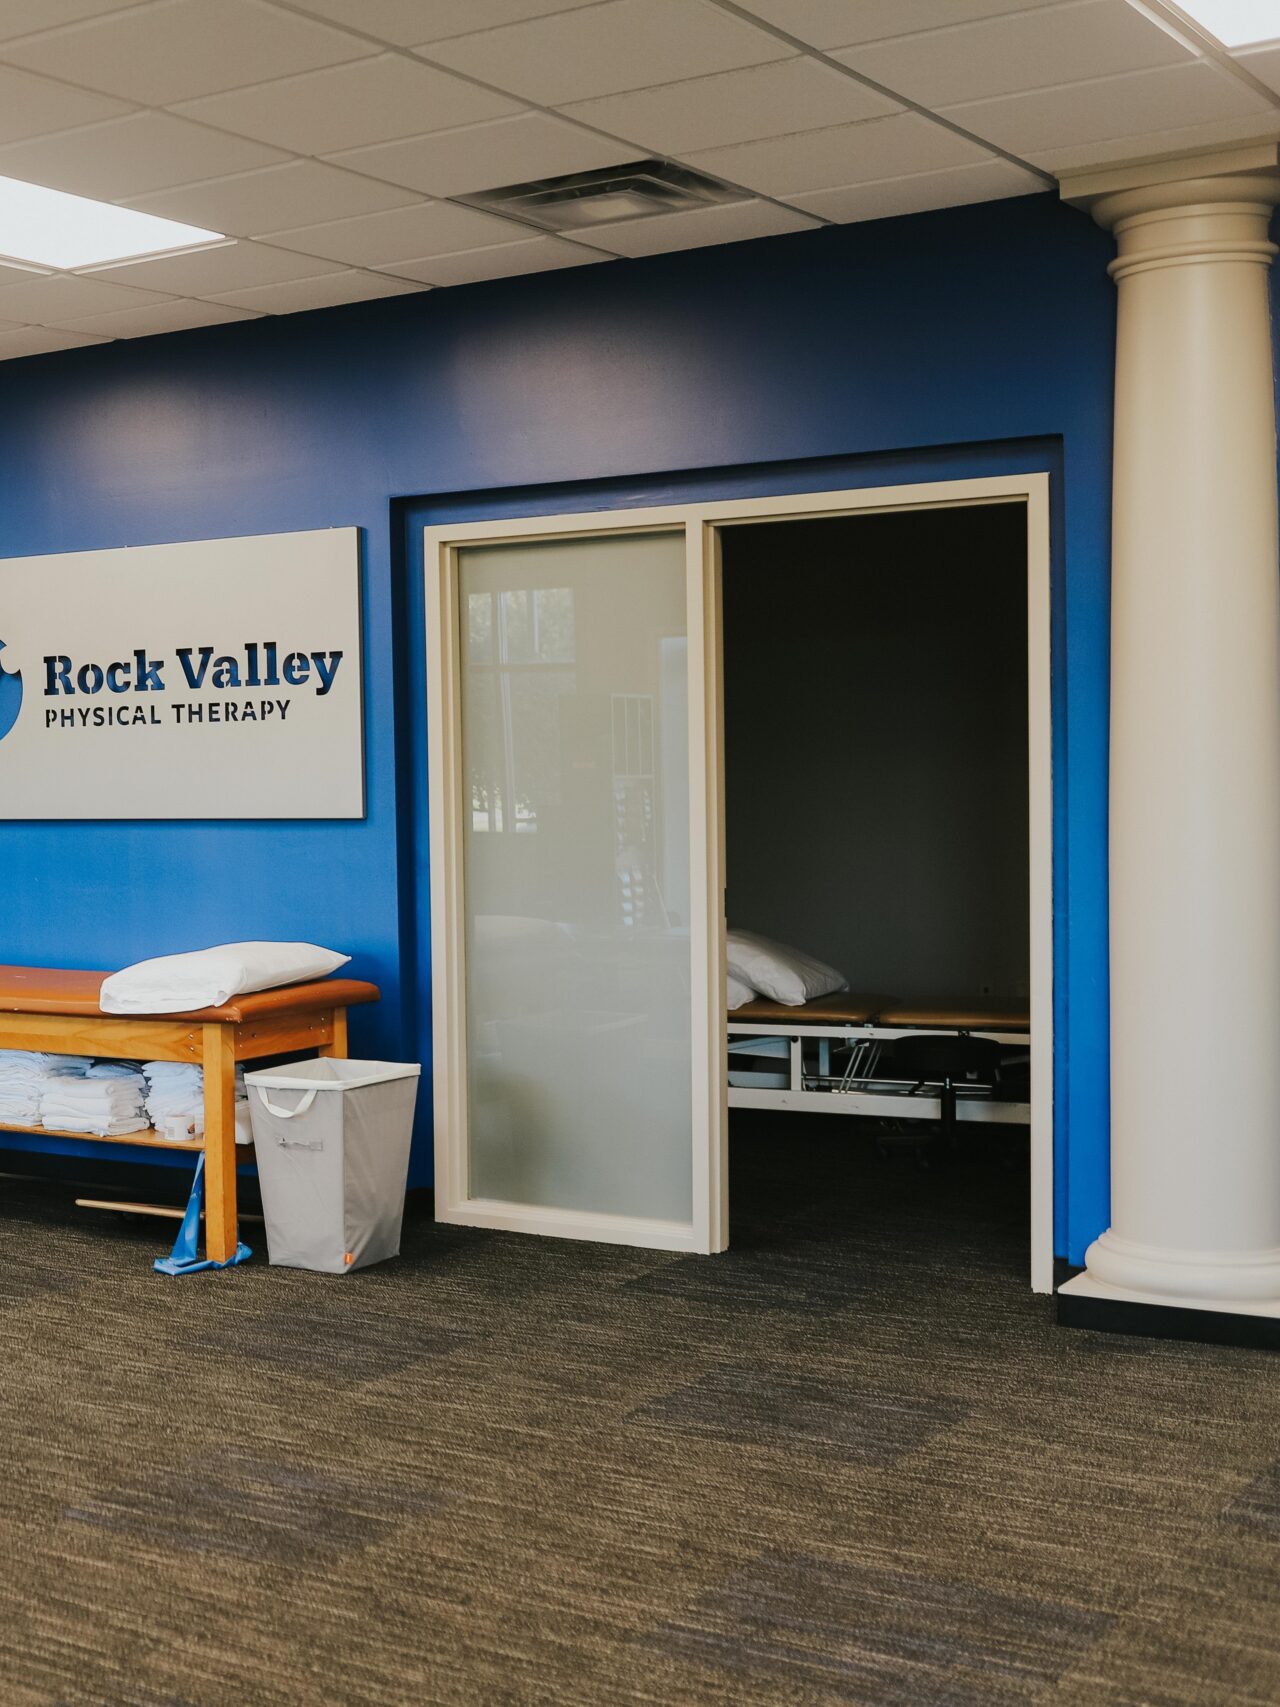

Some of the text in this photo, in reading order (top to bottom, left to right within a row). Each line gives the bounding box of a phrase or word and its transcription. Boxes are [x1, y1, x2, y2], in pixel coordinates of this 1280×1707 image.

[43, 641, 344, 696] Rock Valley
[45, 699, 292, 728] PHYSICAL THERAPY
